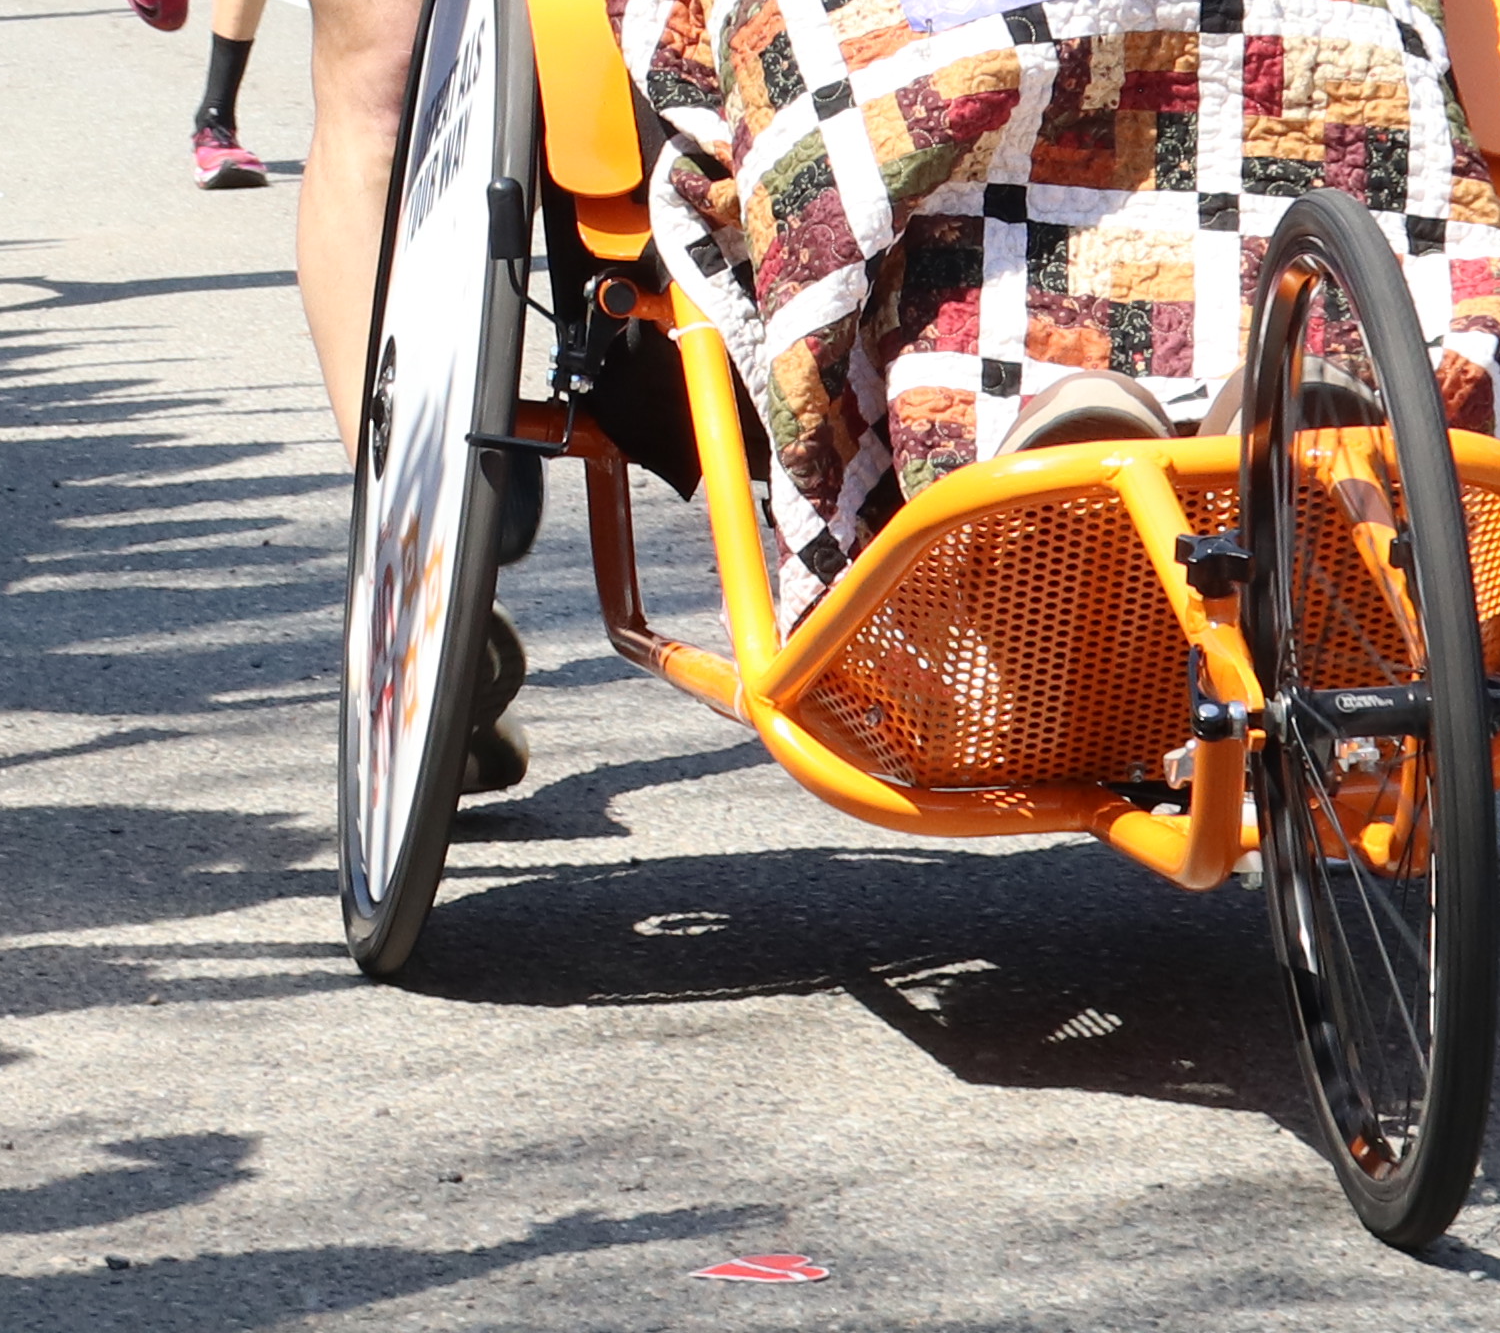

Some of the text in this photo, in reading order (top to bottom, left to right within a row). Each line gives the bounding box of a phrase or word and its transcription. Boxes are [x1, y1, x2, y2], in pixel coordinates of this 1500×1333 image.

[458, 17, 486, 97] ALS
[404, 96, 473, 253] YOUR WAY
